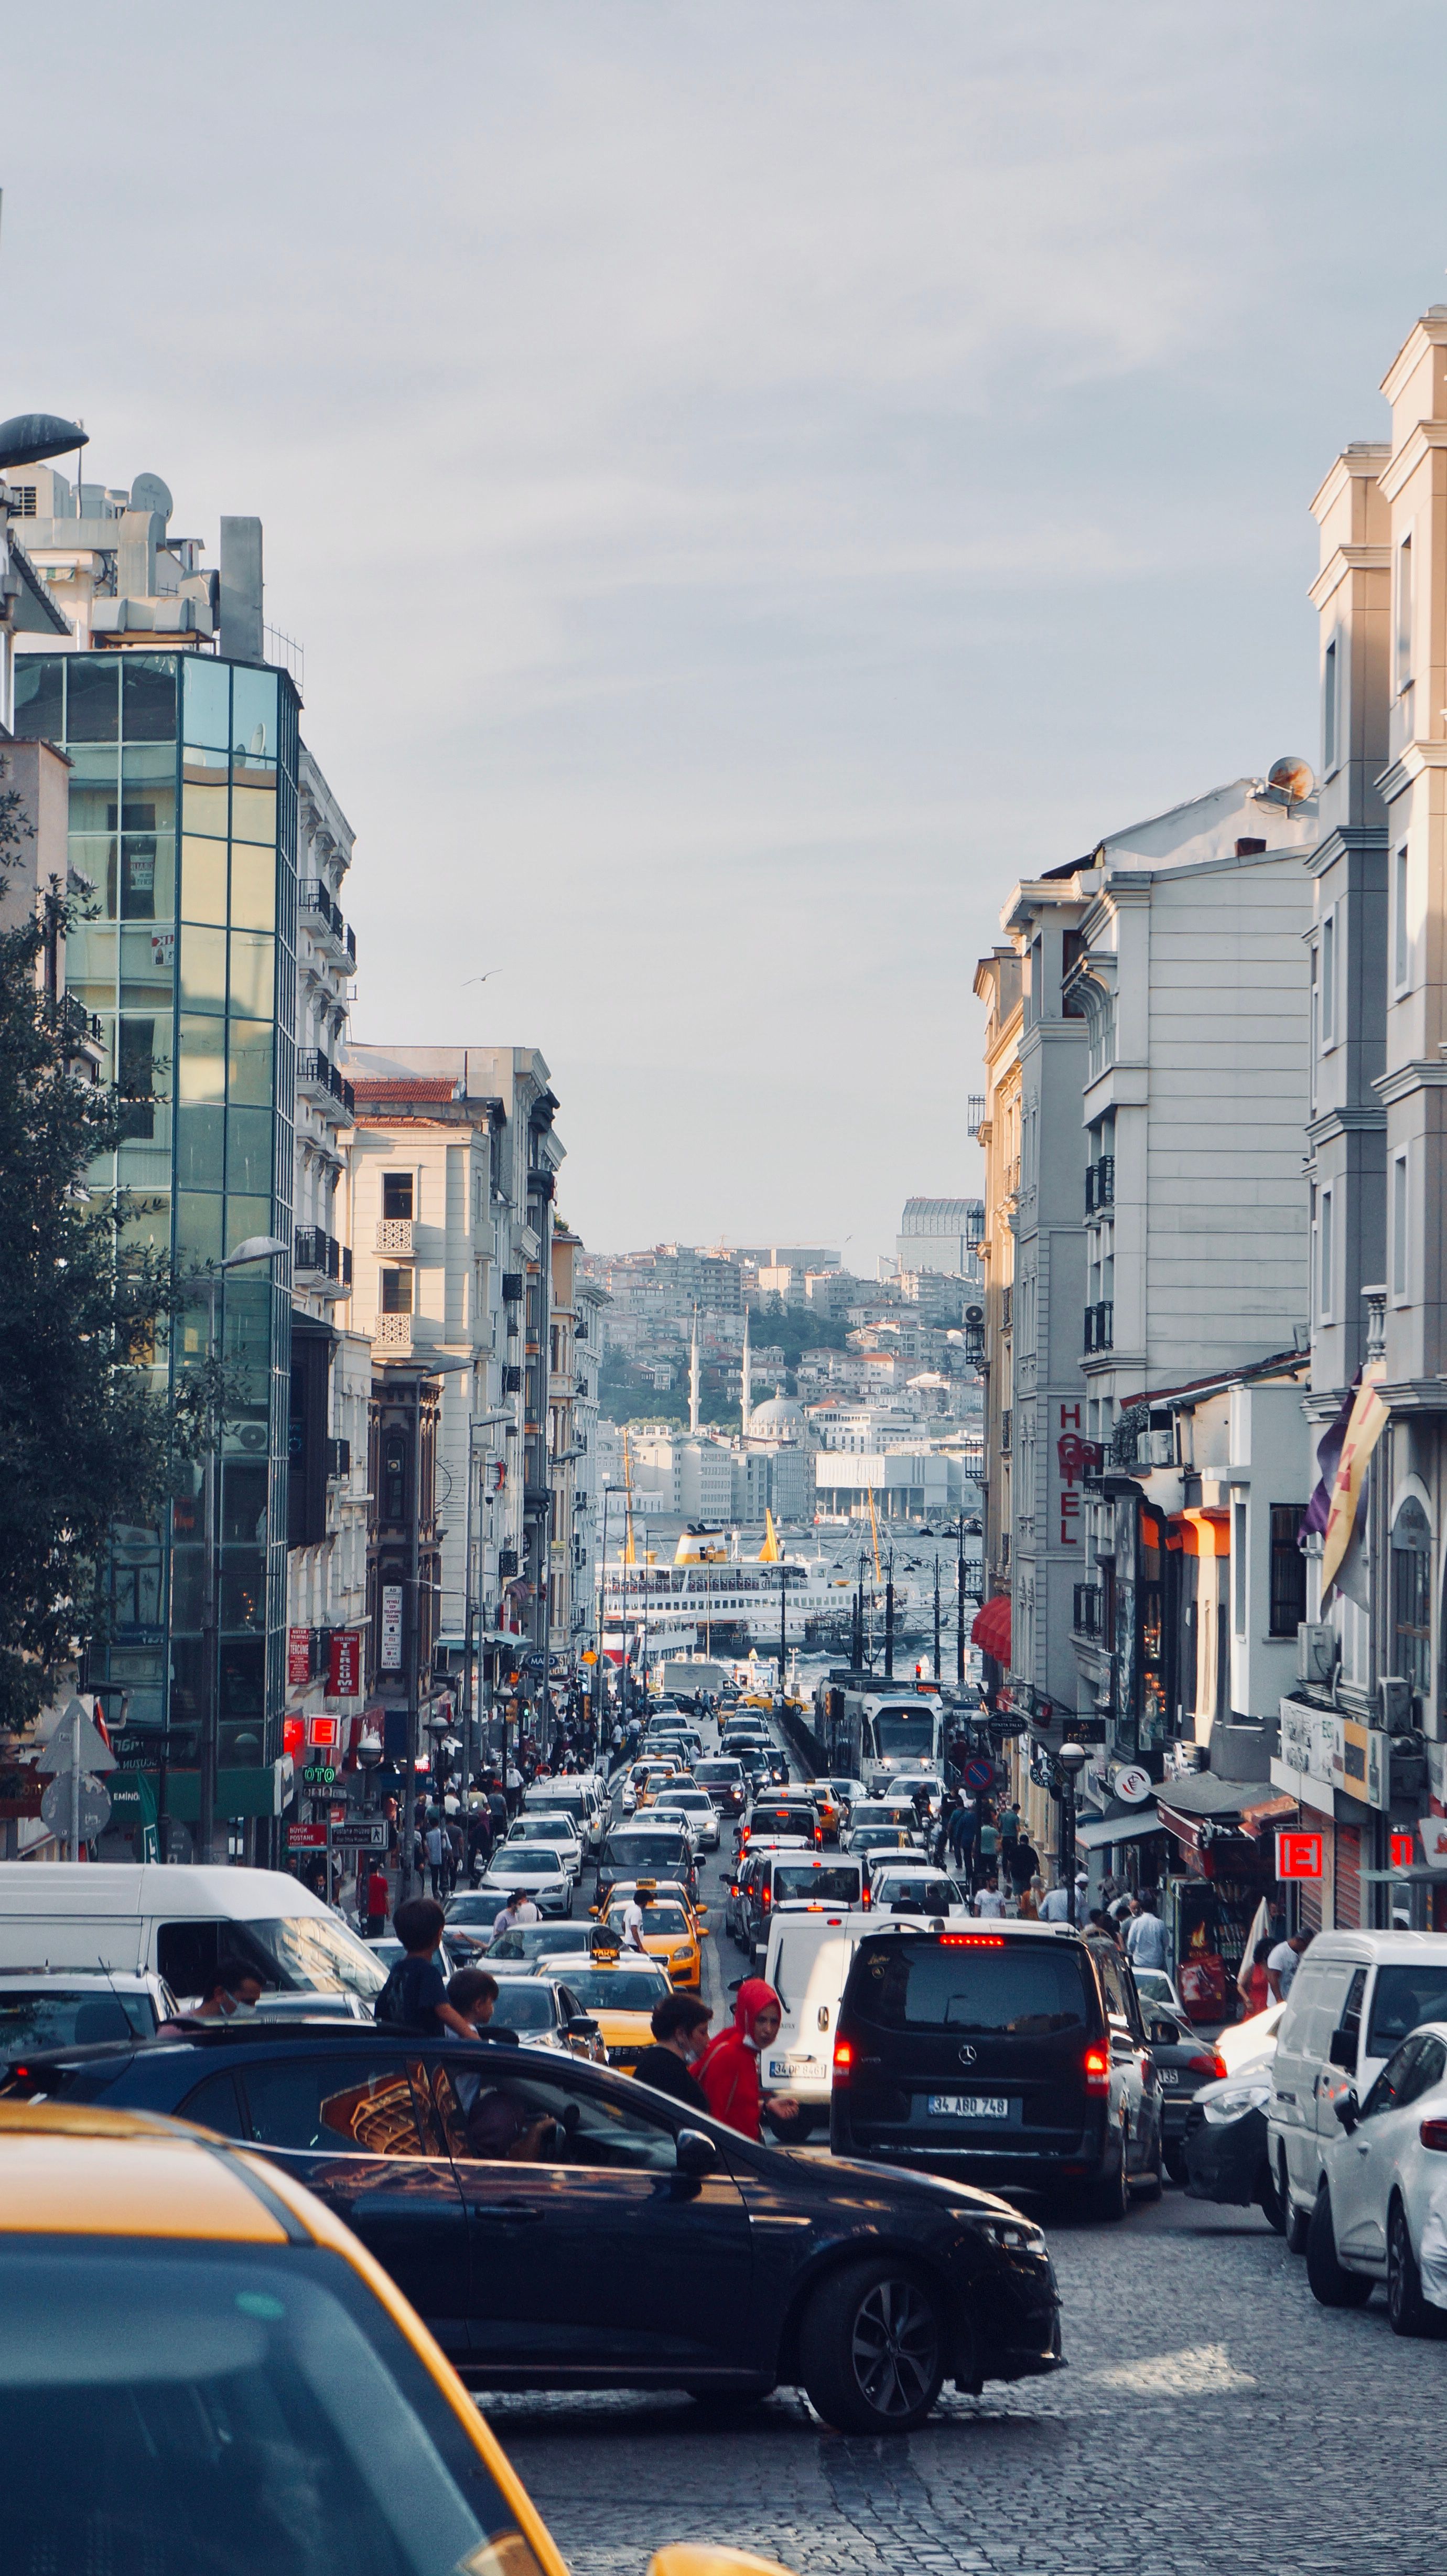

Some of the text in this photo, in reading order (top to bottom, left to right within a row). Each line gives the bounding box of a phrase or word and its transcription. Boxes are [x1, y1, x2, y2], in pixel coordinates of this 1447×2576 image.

[1059, 1403, 1081, 1544] HOTEL
[315, 1720, 332, 1742] E
[305, 1767, 335, 1783] OTO
[113, 1791, 141, 1801] EMİNÖ
[775, 2064, 786, 2074] 34
[935, 2098, 949, 2111] 34
[982, 2099, 1005, 2113] 748
